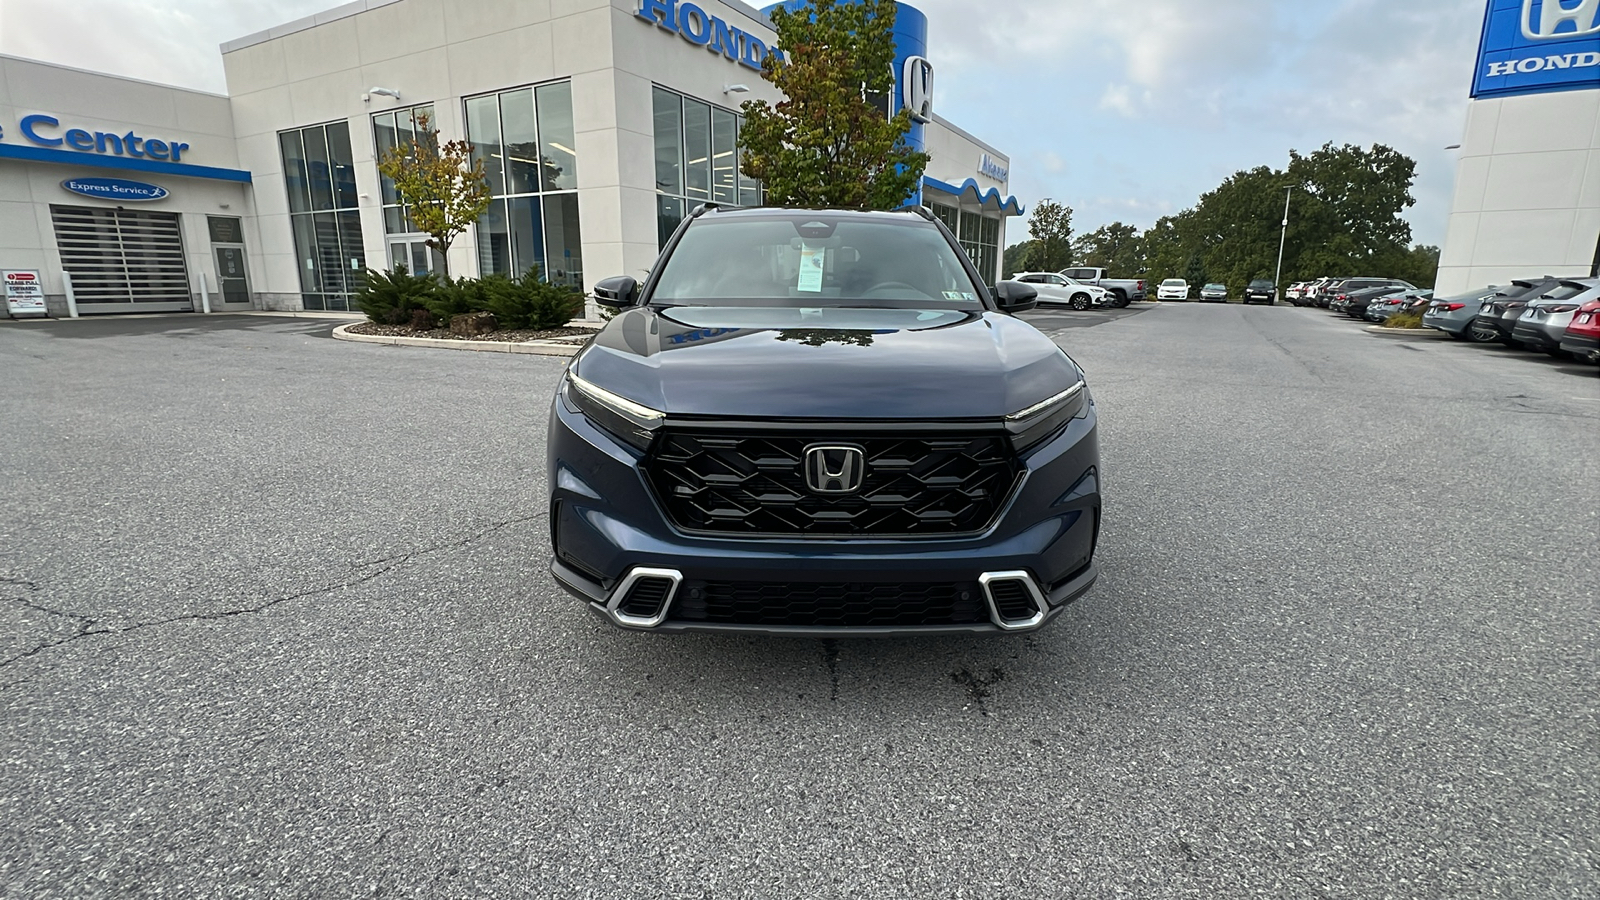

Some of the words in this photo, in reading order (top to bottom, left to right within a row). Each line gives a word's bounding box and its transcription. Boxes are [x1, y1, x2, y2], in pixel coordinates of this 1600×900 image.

[1486, 52, 1600, 77] HOND
[20, 114, 190, 161] Center
[70, 181, 110, 191] Express
[112, 185, 149, 195] Service
